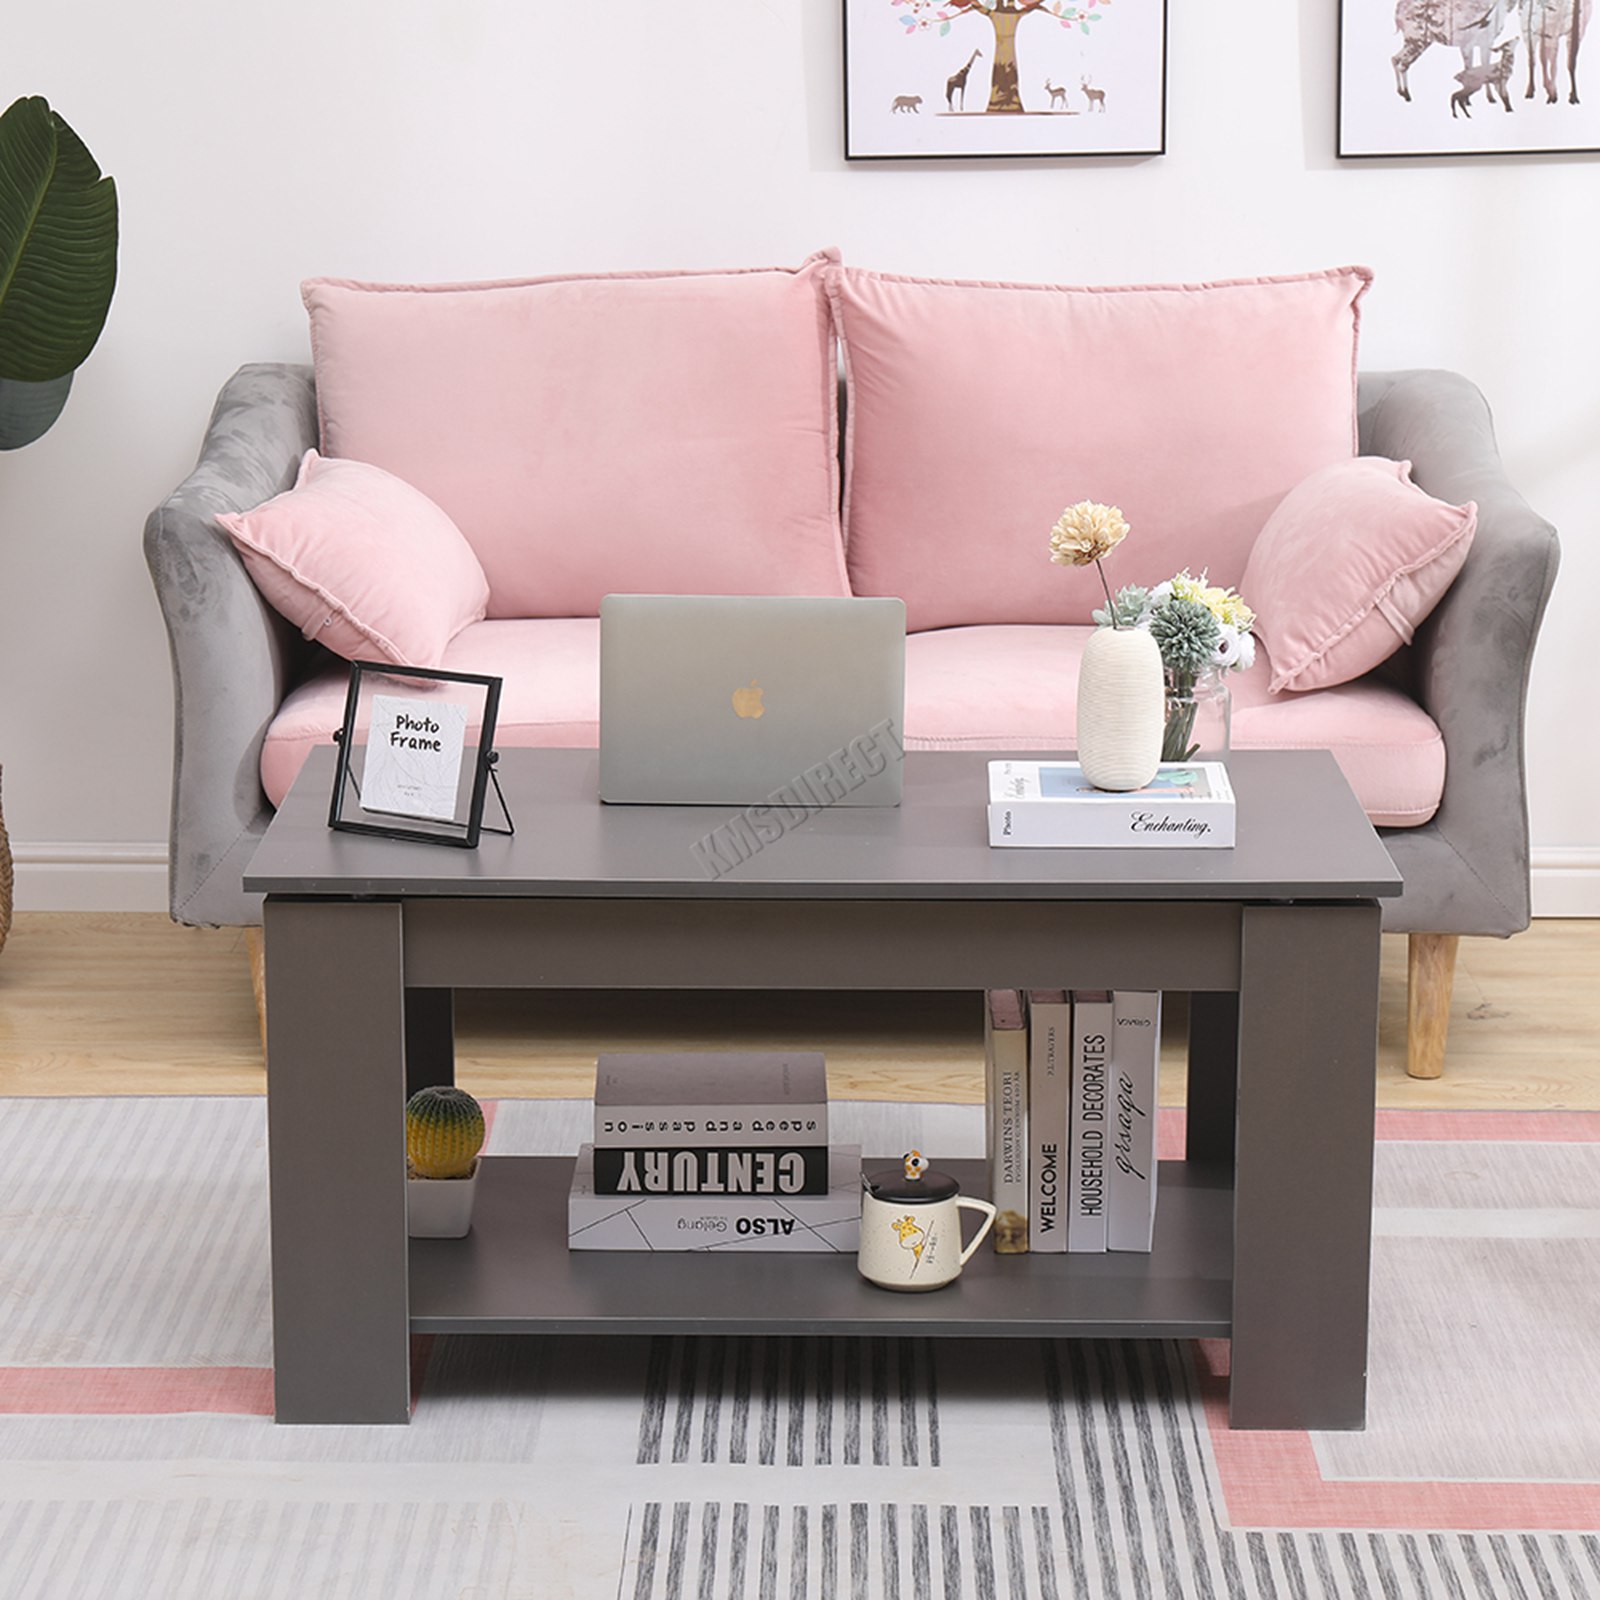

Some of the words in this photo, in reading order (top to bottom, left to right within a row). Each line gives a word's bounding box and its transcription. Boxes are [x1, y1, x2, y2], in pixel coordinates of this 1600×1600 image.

[397, 714, 440, 733] Photo
[390, 731, 441, 752] Frame
[1002, 1071, 1012, 1115] TEORI
[1083, 1033, 1106, 1122] DECORATES
[604, 1120, 696, 1133] passion
[705, 1120, 743, 1133] and
[752, 1120, 817, 1133] speed
[1003, 1118, 1013, 1184] DARWINS
[616, 1151, 806, 1194] CENTURY
[1040, 1143, 1057, 1233] WELCOME
[1081, 1129, 1103, 1217] HOUSEHOLD
[735, 1217, 796, 1236] ALSO
